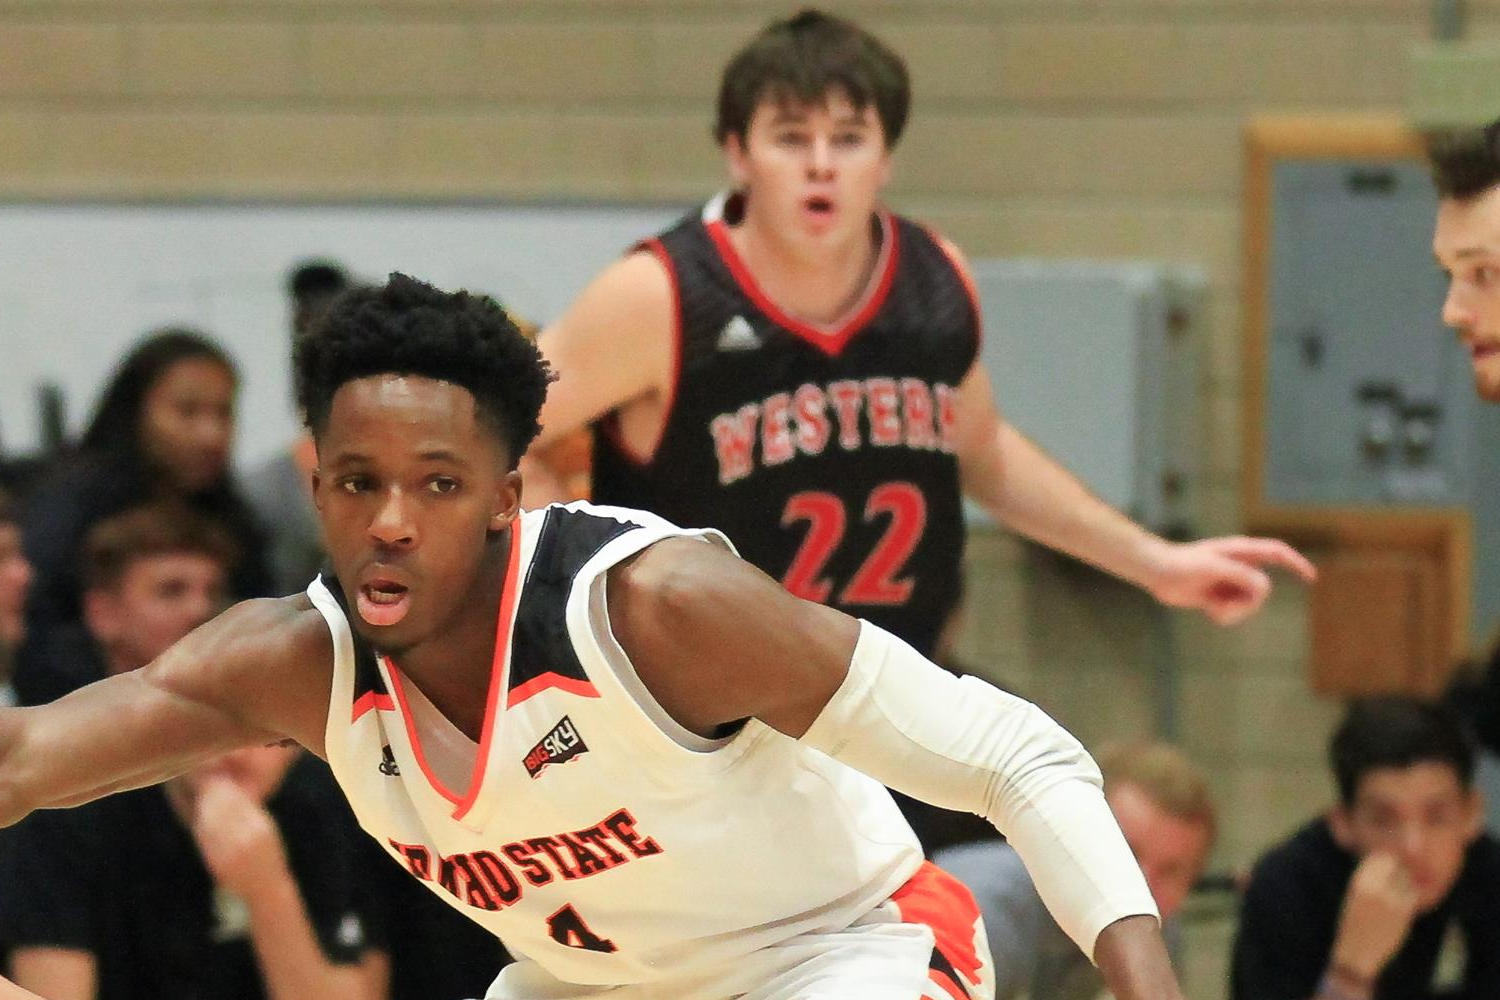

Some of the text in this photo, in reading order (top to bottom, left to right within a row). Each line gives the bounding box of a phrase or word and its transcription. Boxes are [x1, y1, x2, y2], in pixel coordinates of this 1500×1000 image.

[779, 482, 927, 606] 22
[524, 719, 580, 770] BIG SKY
[500, 807, 665, 888] STATE
